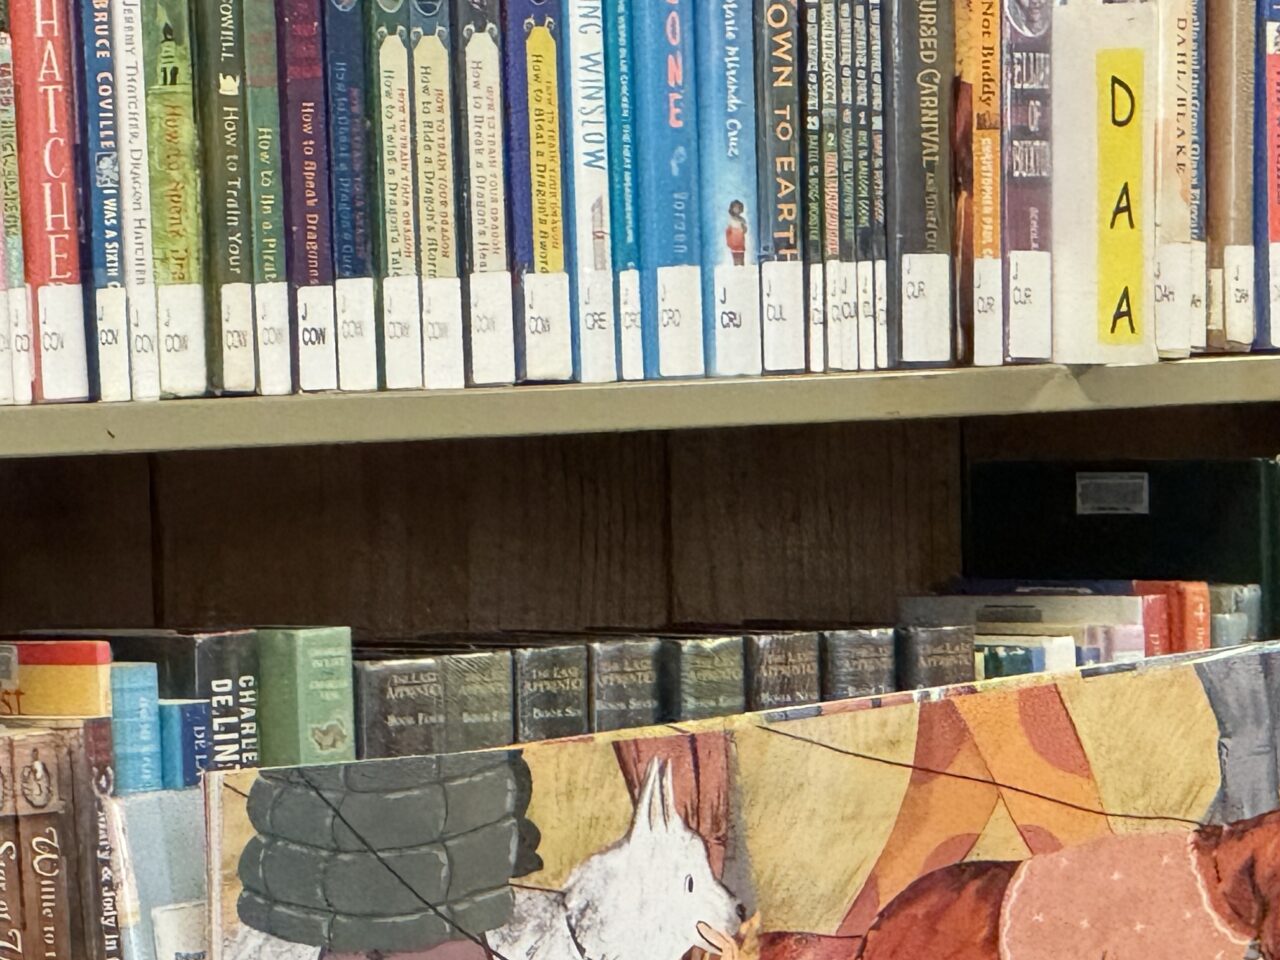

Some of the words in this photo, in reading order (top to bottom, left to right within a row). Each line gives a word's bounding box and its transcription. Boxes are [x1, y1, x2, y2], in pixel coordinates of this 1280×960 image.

[94, 0, 111, 58] BRUCE
[917, 0, 937, 63] URSED
[981, 1, 996, 36] Not
[666, 1, 684, 128] ONE
[979, 45, 995, 107] Buddy
[97, 72, 117, 149] COVILLE
[223, 106, 239, 147] How
[302, 102, 315, 134] How
[578, 52, 606, 170] WINSLOW
[774, 104, 793, 141] TO
[34, 0, 71, 285] HATCHE
[303, 141, 315, 155] to
[726, 118, 742, 157] Cruz
[226, 154, 239, 171] to
[103, 198, 118, 226] WAS
[226, 177, 241, 226] Train
[105, 242, 119, 276] SIXTH
[228, 233, 242, 274] Your
